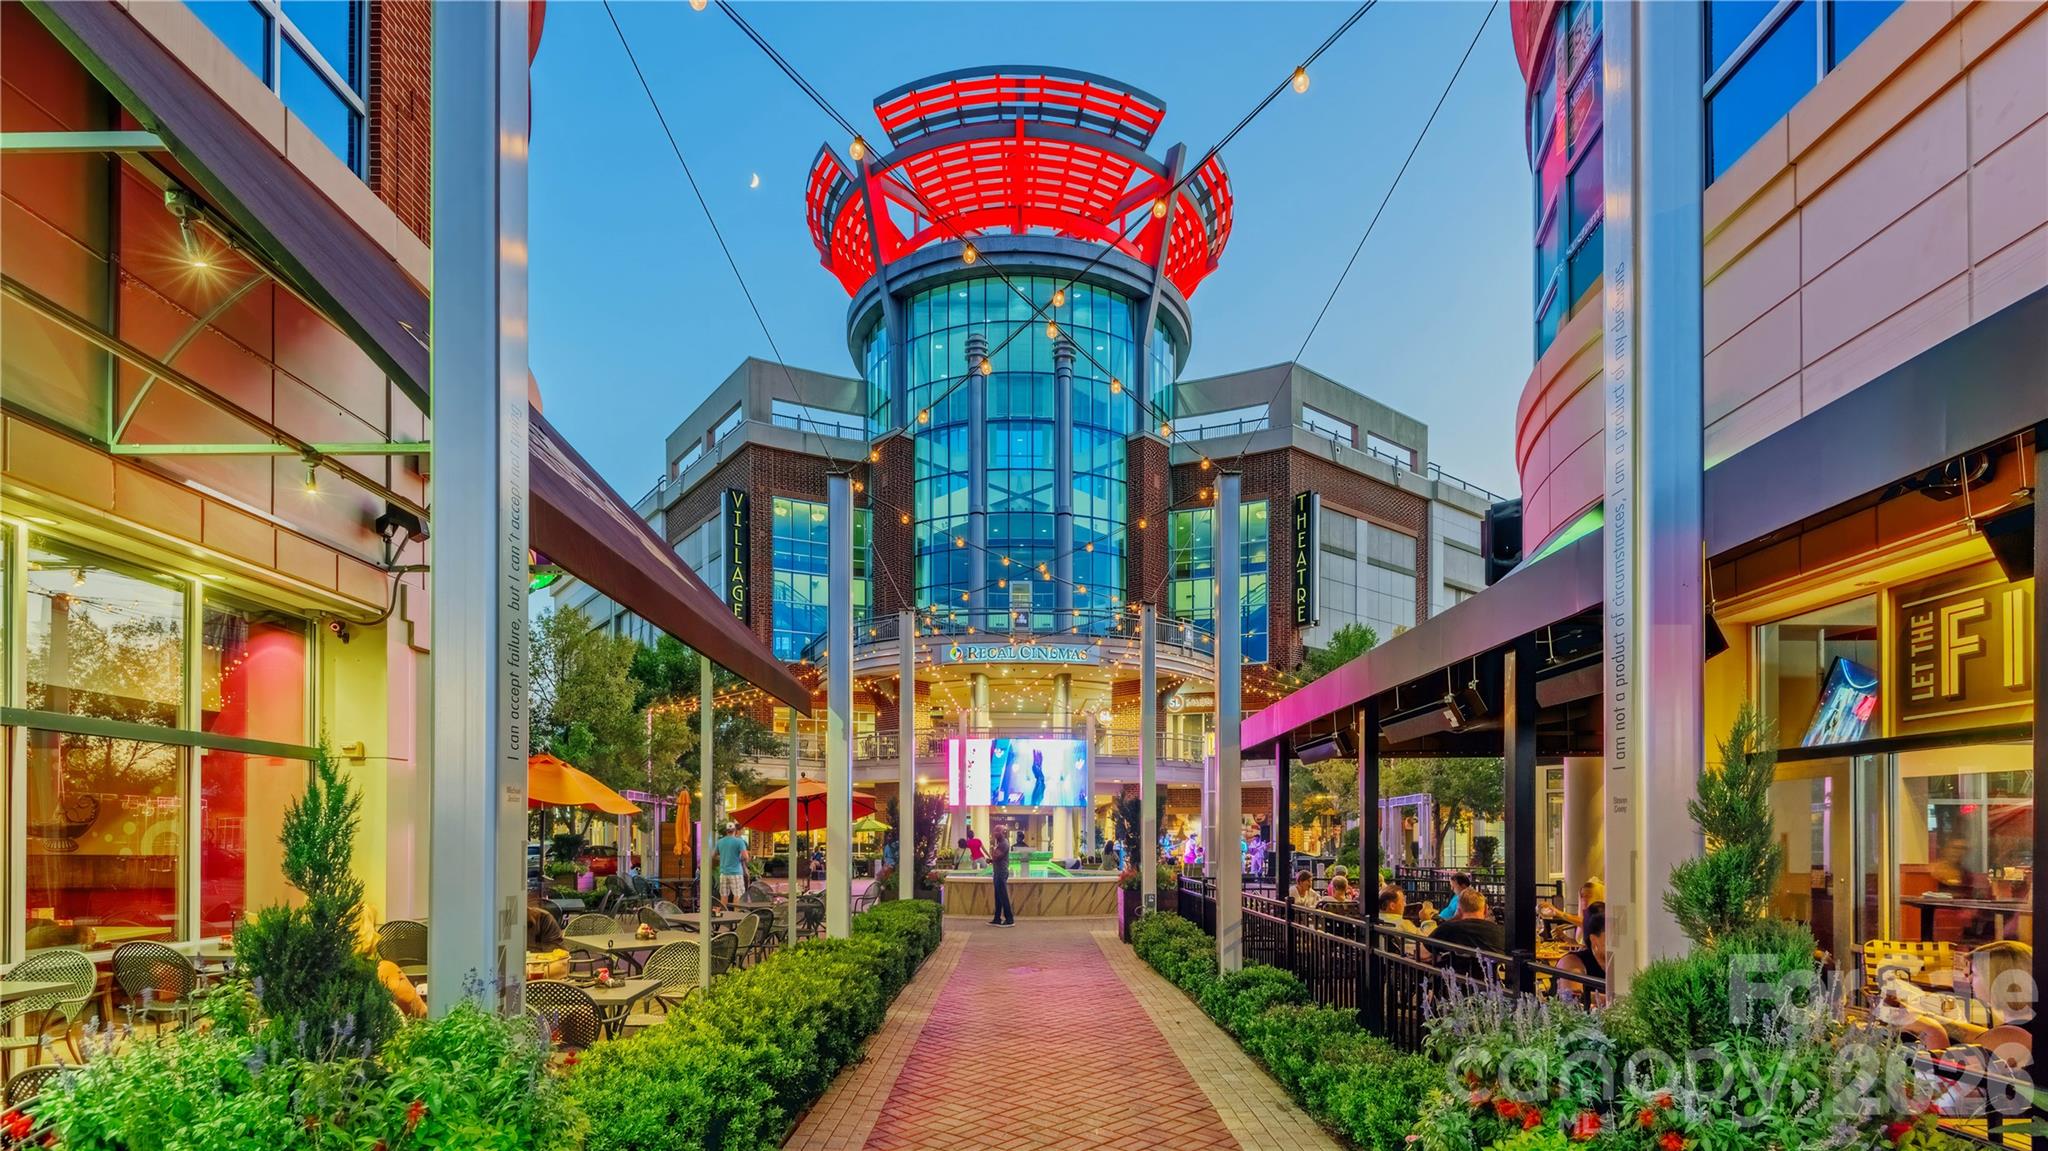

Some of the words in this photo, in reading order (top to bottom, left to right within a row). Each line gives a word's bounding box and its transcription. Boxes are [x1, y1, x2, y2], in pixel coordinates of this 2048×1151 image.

[1614, 335, 1628, 362] my
[1611, 383, 1628, 441] product
[510, 451, 521, 480] not
[1615, 444, 1625, 456] a
[1615, 458, 1625, 485] am
[510, 481, 523, 531] accept
[508, 534, 521, 571] can't
[732, 490, 744, 620] VILLAGE
[1296, 493, 1308, 623] THEATRE
[1612, 498, 1627, 607] circumstances,
[508, 586, 520, 612] but
[1611, 612, 1625, 627] of
[1911, 610, 1934, 657] THE
[507, 618, 522, 669] failure,
[967, 645, 1017, 660] REGAL
[1019, 644, 1090, 662] CINEMAS
[1611, 633, 1628, 688] product
[509, 672, 523, 720] accept
[1615, 692, 1626, 702] a
[1911, 663, 1935, 701] LET
[1613, 707, 1626, 731] not
[510, 725, 520, 751] can
[1615, 736, 1626, 760] am
